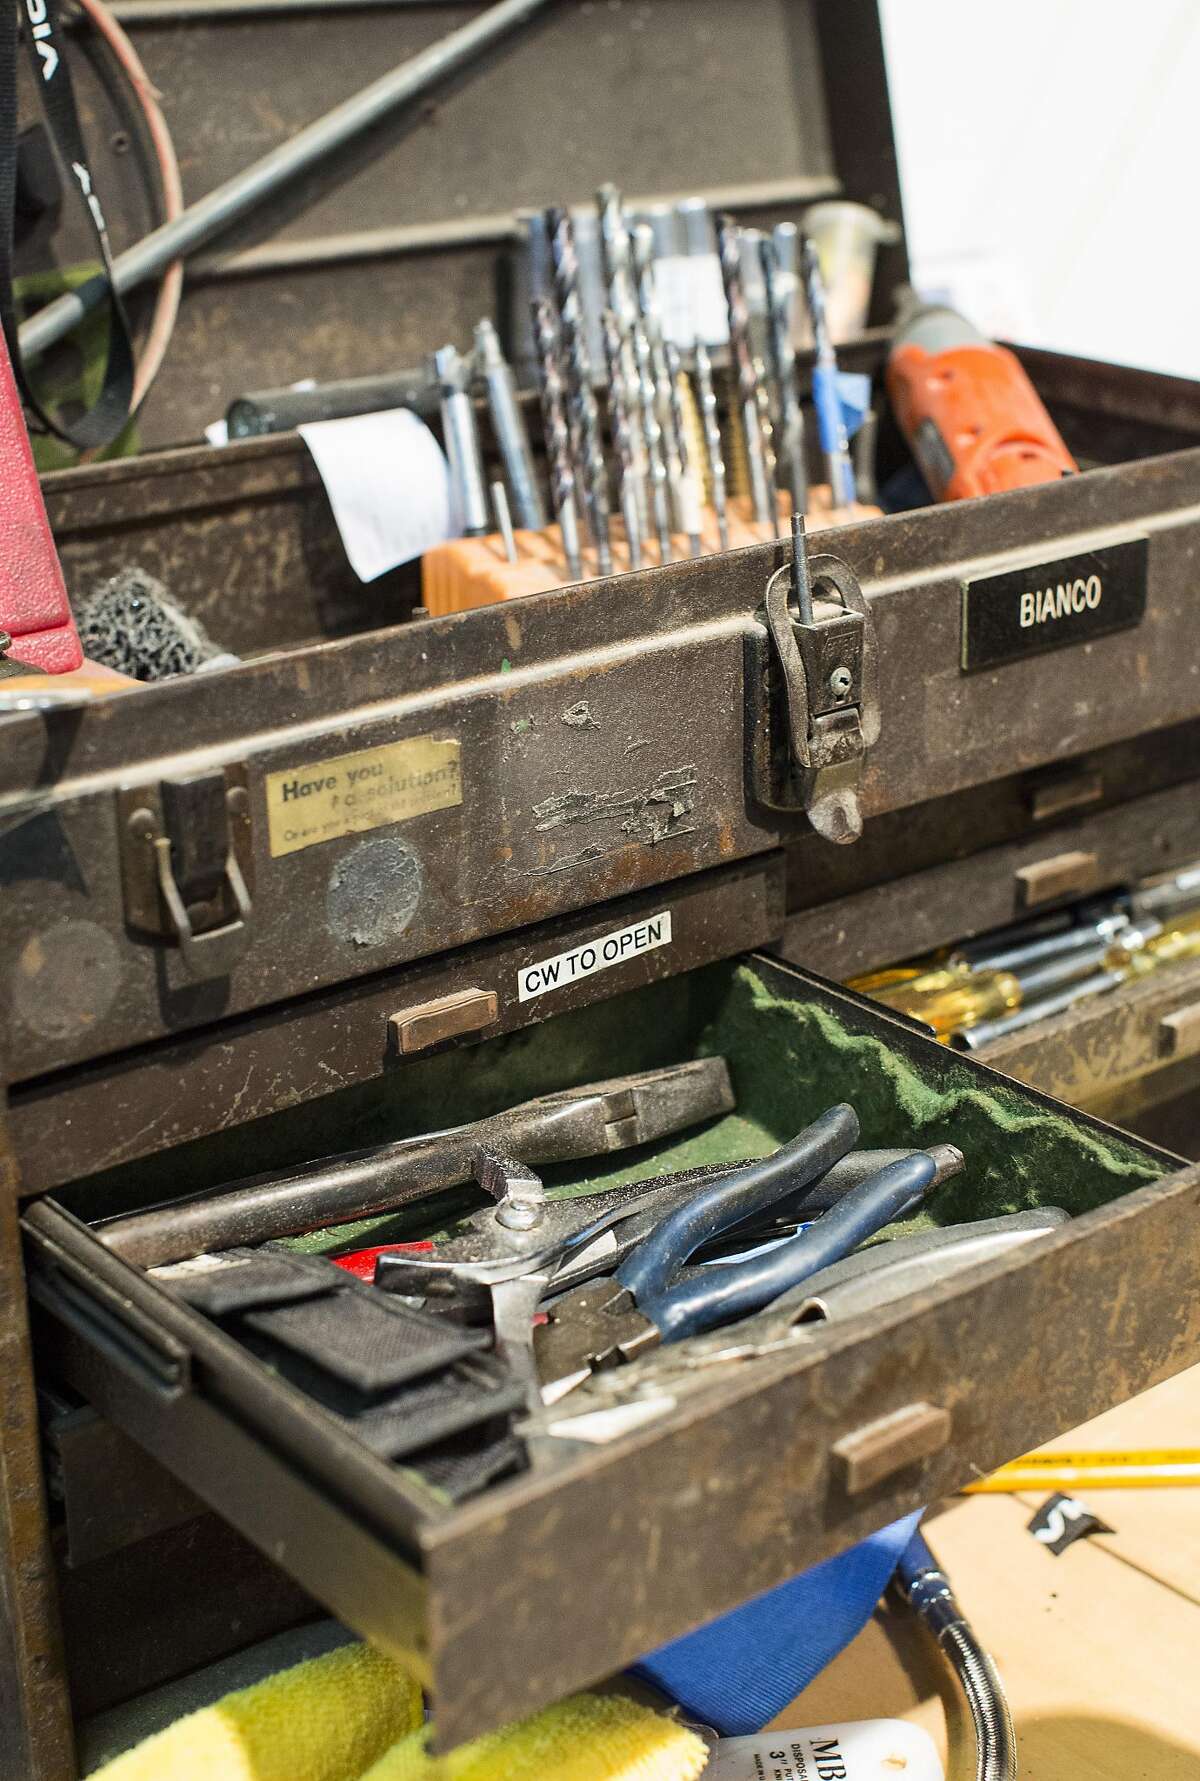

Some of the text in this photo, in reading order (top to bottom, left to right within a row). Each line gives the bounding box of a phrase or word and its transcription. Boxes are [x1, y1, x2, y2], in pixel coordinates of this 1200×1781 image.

[1019, 574, 1102, 628] BIANCO
[282, 774, 338, 803] Have
[346, 762, 384, 786] you
[525, 921, 662, 993] CW TO OPEN
[791, 1743, 809, 1781] DISPOSA
[809, 1739, 847, 1781] MB
